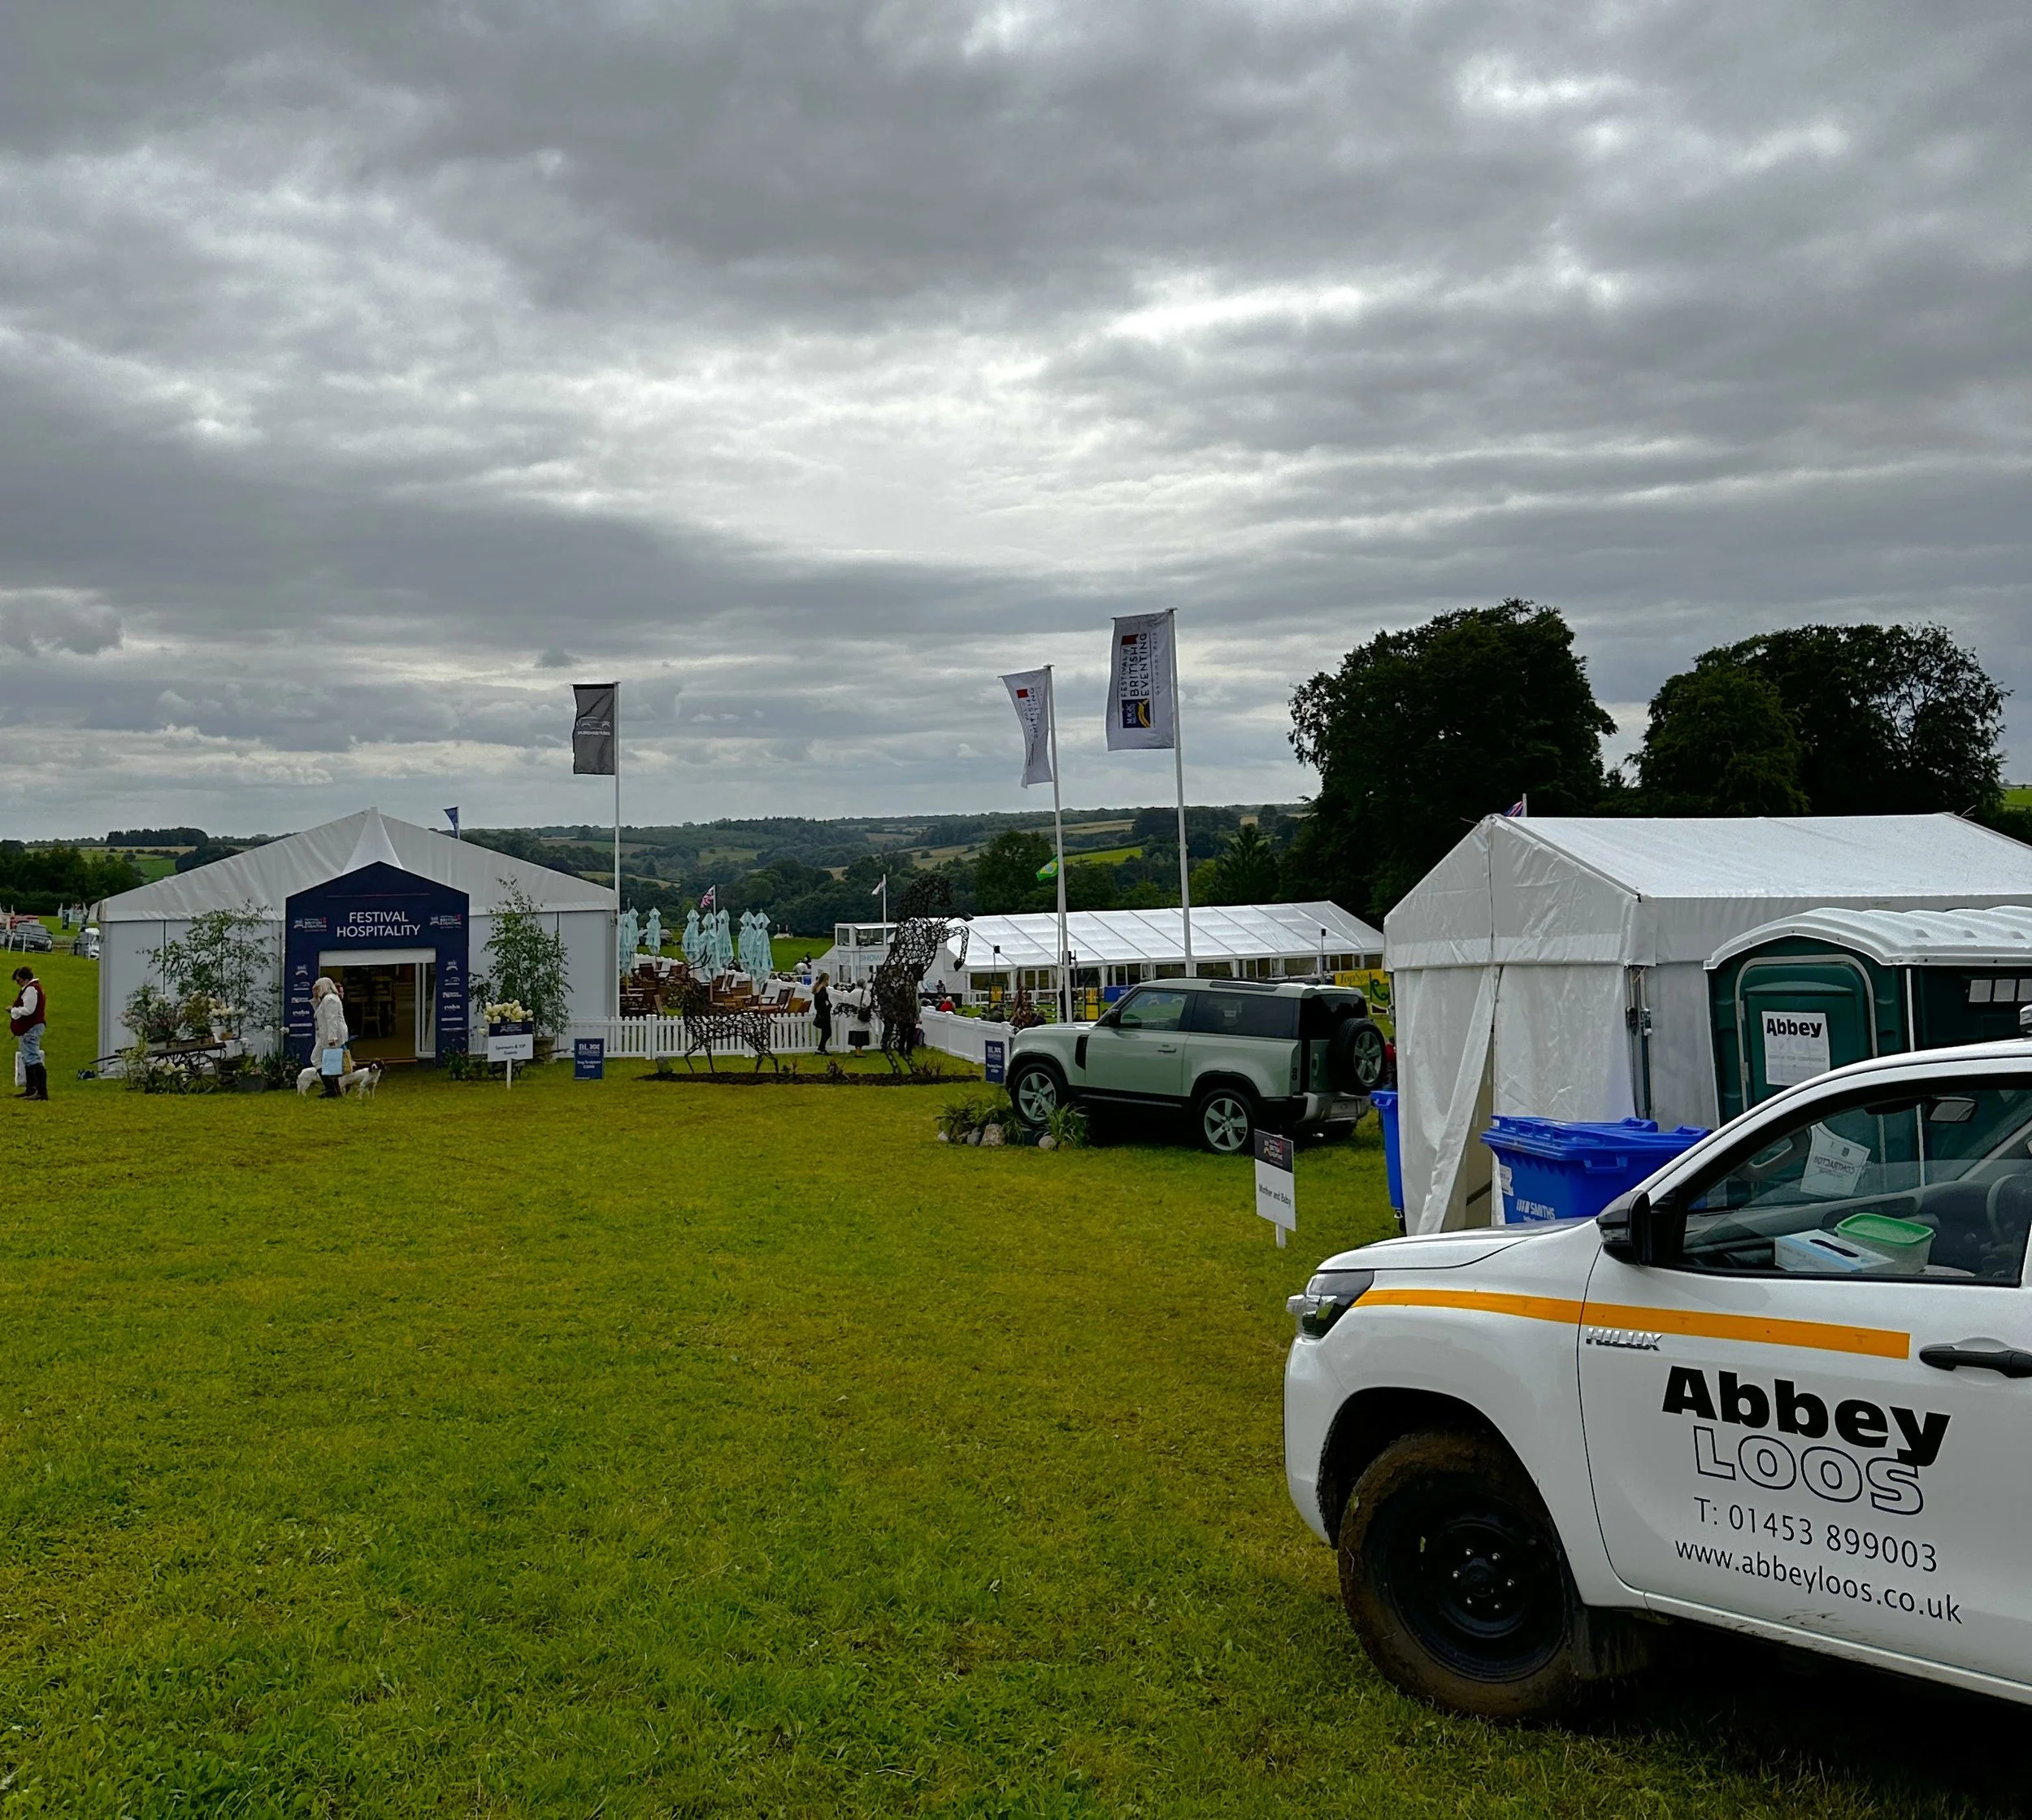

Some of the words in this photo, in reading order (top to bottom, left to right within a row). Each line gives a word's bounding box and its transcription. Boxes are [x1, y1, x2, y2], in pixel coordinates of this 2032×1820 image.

[1129, 647, 1139, 697] BRITISH
[1140, 632, 1149, 697] EVENTING
[336, 924, 420, 937] HOSPITALITY
[349, 911, 409, 923] FESTIVAL
[1766, 1018, 1822, 1038] Abbey
[1258, 1183, 1273, 1197] Mother
[1281, 1192, 1292, 1207] Baby
[1531, 1201, 1556, 1220] SMITHS
[1586, 1327, 1663, 1351] HILUX
[1662, 1366, 1951, 1466] Abbey
[1693, 1425, 1924, 1515] LOOS
[1694, 1496, 1718, 1526] T:
[1729, 1504, 1813, 1545] 01453
[1826, 1524, 1937, 1572] 899003
[1675, 1540, 1963, 1624] www.abbeyloos.co.uk
